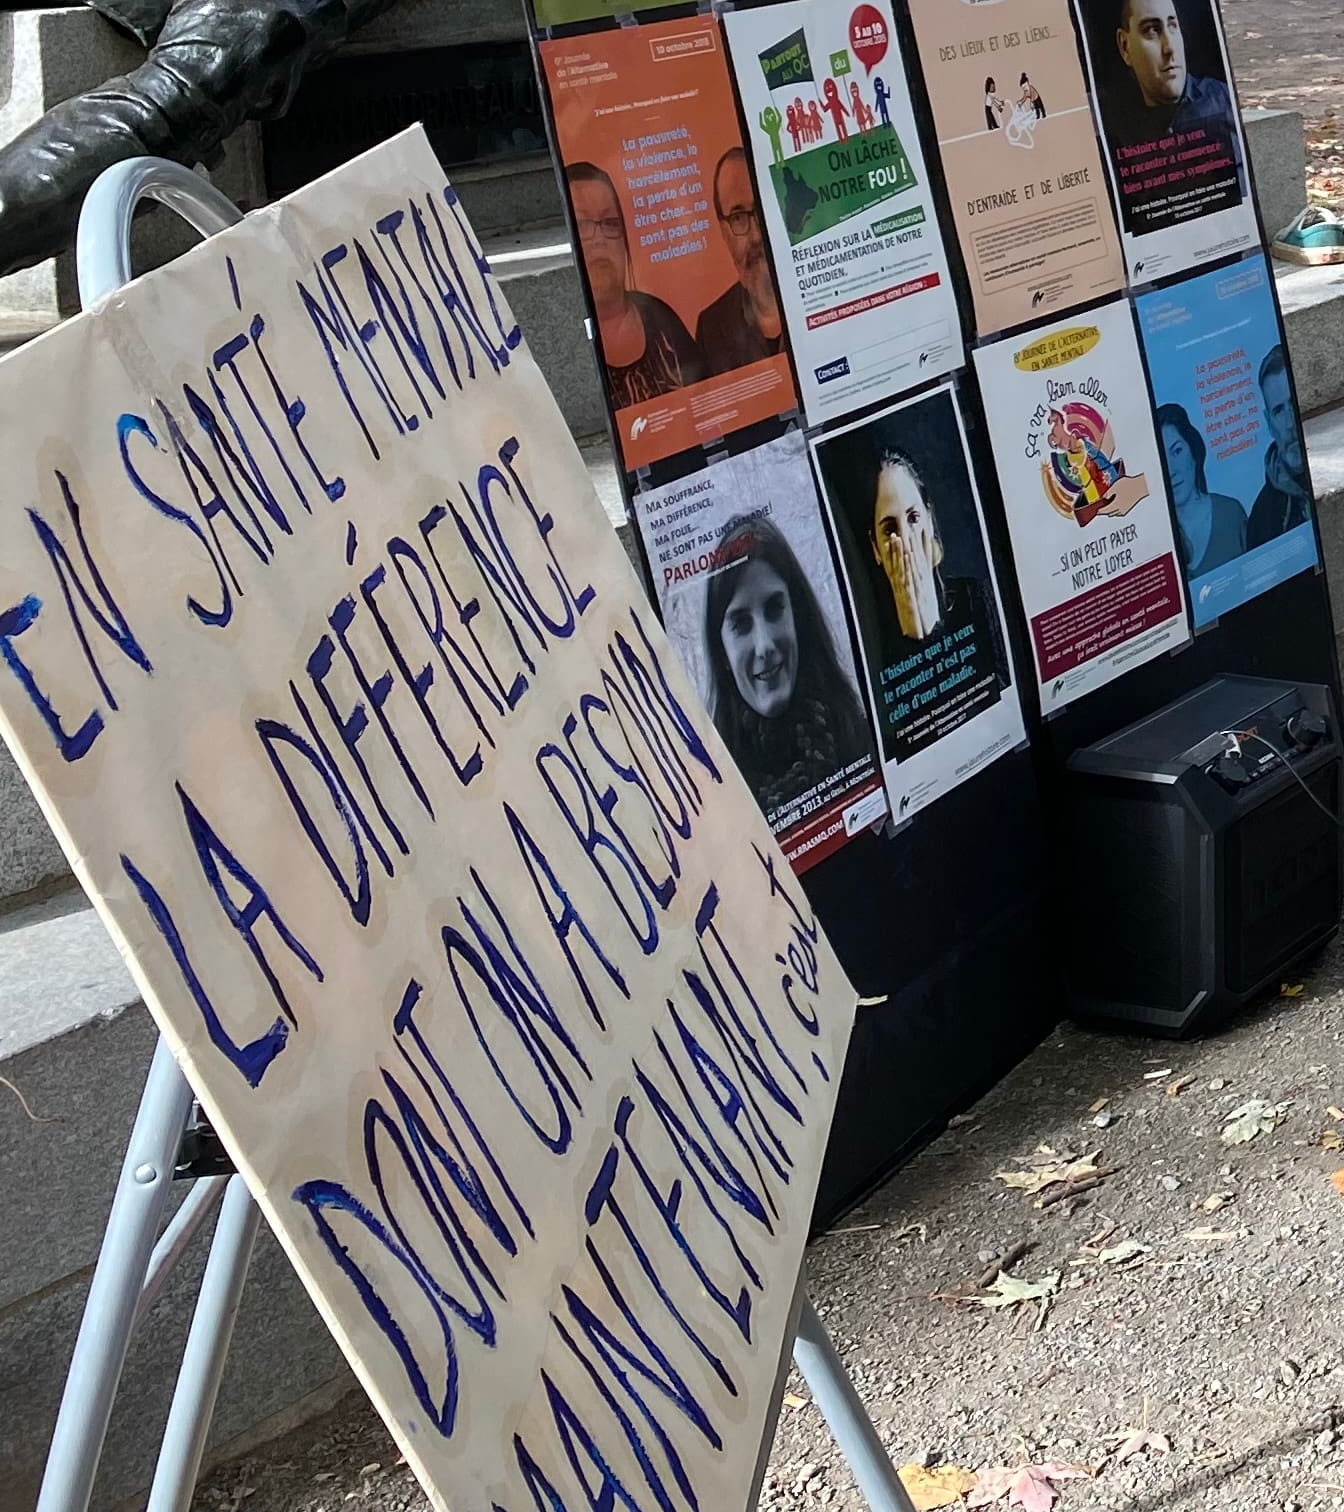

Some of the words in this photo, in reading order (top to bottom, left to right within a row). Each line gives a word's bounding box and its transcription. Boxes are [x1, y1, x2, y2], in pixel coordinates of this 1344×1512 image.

[834, 57, 847, 70] du
[939, 46, 957, 62] DES
[961, 40, 985, 58] LIEUX
[989, 36, 999, 51] ET
[1003, 33, 1021, 49] DES
[855, 138, 898, 163] LÂCHE
[818, 175, 866, 204] NOTRE
[867, 165, 897, 190] FOU
[967, 188, 1019, 217] D'ENTRAIDE
[1024, 183, 1035, 200] ET
[1040, 180, 1053, 195] DE
[1057, 167, 1091, 191] LIBERTÉ
[795, 266, 805, 277] ET
[807, 238, 885, 273] MÉDICAMENTATION
[885, 237, 895, 249] DE
[896, 228, 923, 245] NOTRE
[843, 232, 861, 248] SUR
[861, 228, 873, 240] LA
[798, 267, 848, 291] QUOTIDIEN.
[0, 469, 153, 762] EN
[116, 255, 346, 628] SANTÉ
[295, 186, 521, 461] MENTALE
[663, 479, 714, 508] SOUFFRANCE,
[659, 550, 672, 564] NE
[674, 542, 696, 560] SONT
[699, 532, 713, 546] PAS
[1070, 549, 1083, 567] ON
[1085, 537, 1107, 562] PEUT
[1109, 523, 1138, 549] PAYER
[1071, 566, 1103, 591] NOTRE
[1105, 549, 1133, 576] LOYER
[880, 653, 923, 685] L'histoire
[924, 645, 943, 661] que
[943, 635, 953, 648] je
[953, 623, 975, 642] veux
[883, 693, 895, 705] te
[896, 668, 935, 698] raconter
[936, 651, 959, 674] n'est
[960, 642, 977, 660] pas
[888, 704, 910, 724] celle
[911, 688, 938, 710] d'une
[939, 667, 977, 694] maladie.
[120, 780, 324, 1088] LA
[254, 436, 597, 928] DIFFÉRENCE
[537, 604, 722, 956] BESOIN
[504, 802, 630, 1032] A
[442, 864, 594, 1156] ON
[292, 980, 546, 1440] DONT
